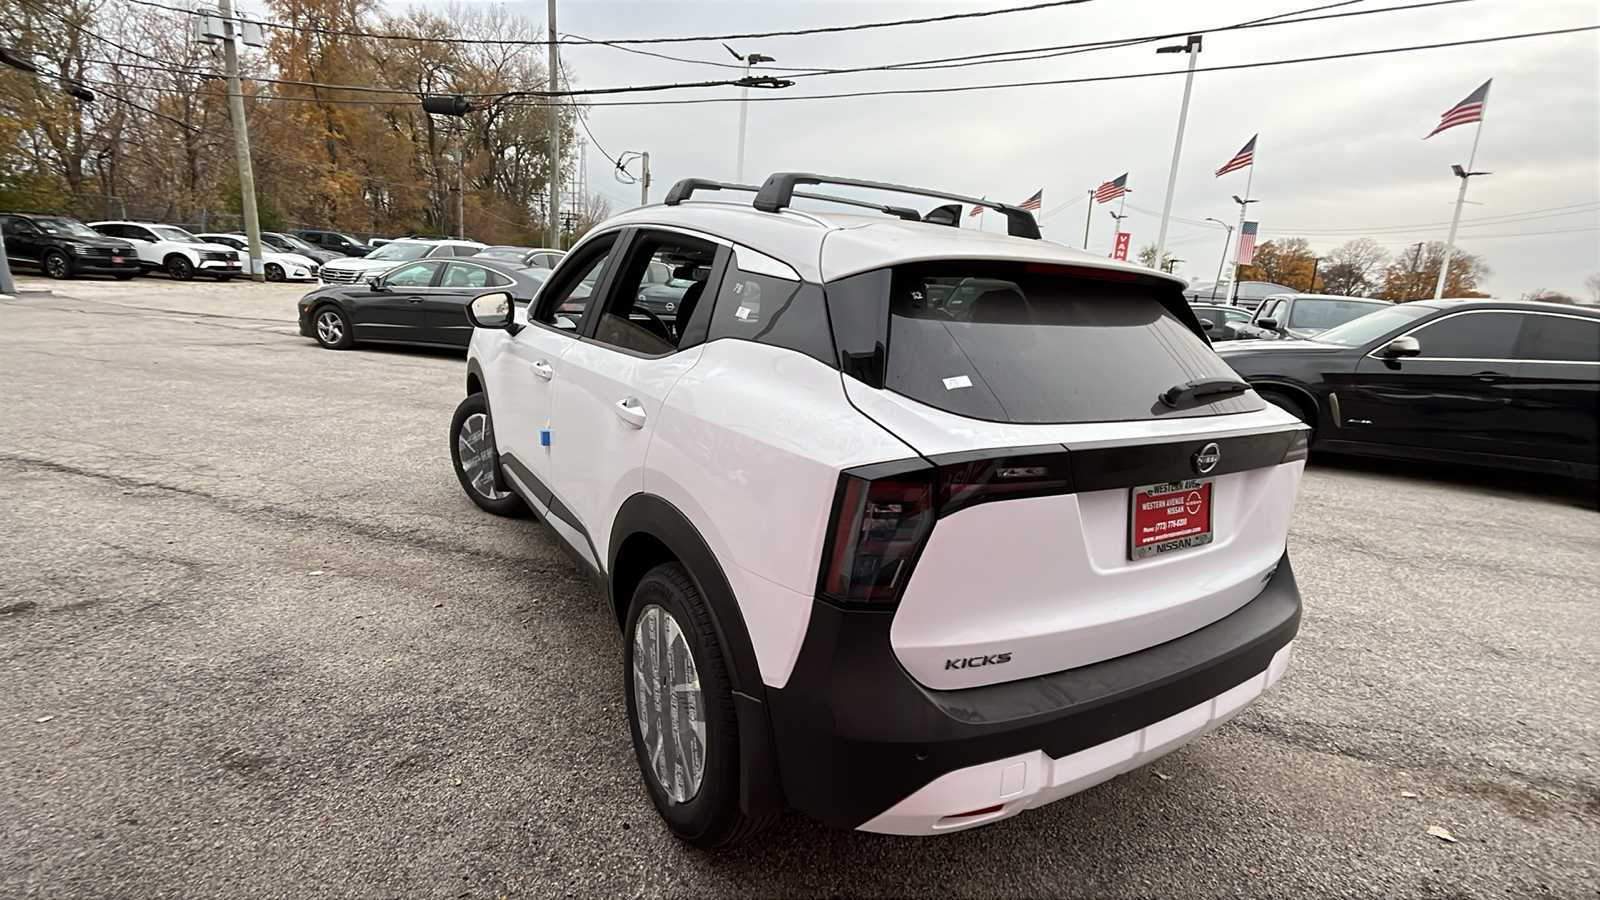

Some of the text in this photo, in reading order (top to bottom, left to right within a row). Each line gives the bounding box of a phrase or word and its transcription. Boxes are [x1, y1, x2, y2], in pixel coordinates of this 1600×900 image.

[1154, 482, 1185, 493] WESTERN
[1142, 496, 1185, 511] WESTERN AVENUE
[1167, 505, 1184, 515] NISSAN
[1155, 521, 1167, 532] (773)
[1156, 538, 1192, 553] NISSAN
[945, 652, 1012, 670] KICKS
